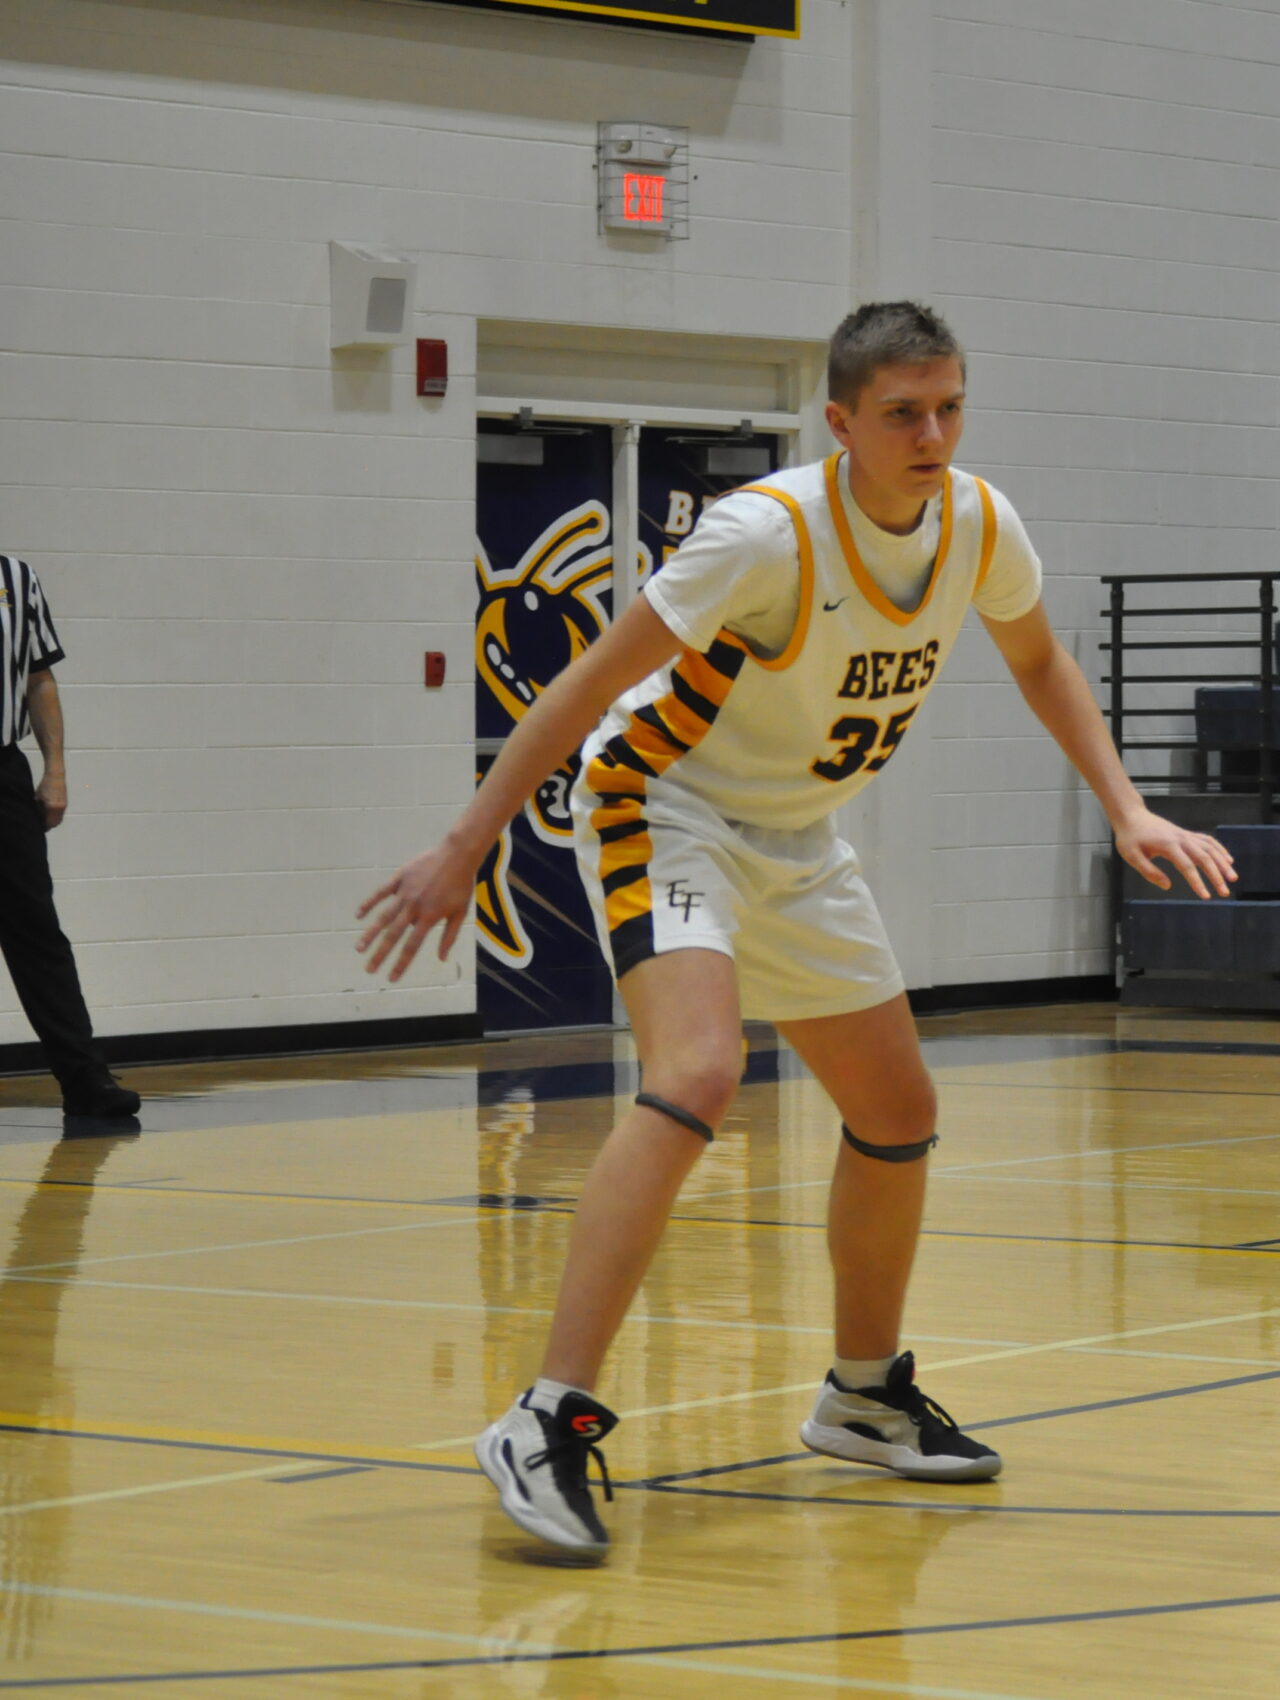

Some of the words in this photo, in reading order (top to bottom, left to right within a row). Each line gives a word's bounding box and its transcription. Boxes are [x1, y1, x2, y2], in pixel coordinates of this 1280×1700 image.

[624, 173, 666, 222] EXIT
[837, 639, 940, 700] BEES
[809, 701, 920, 783] 35
